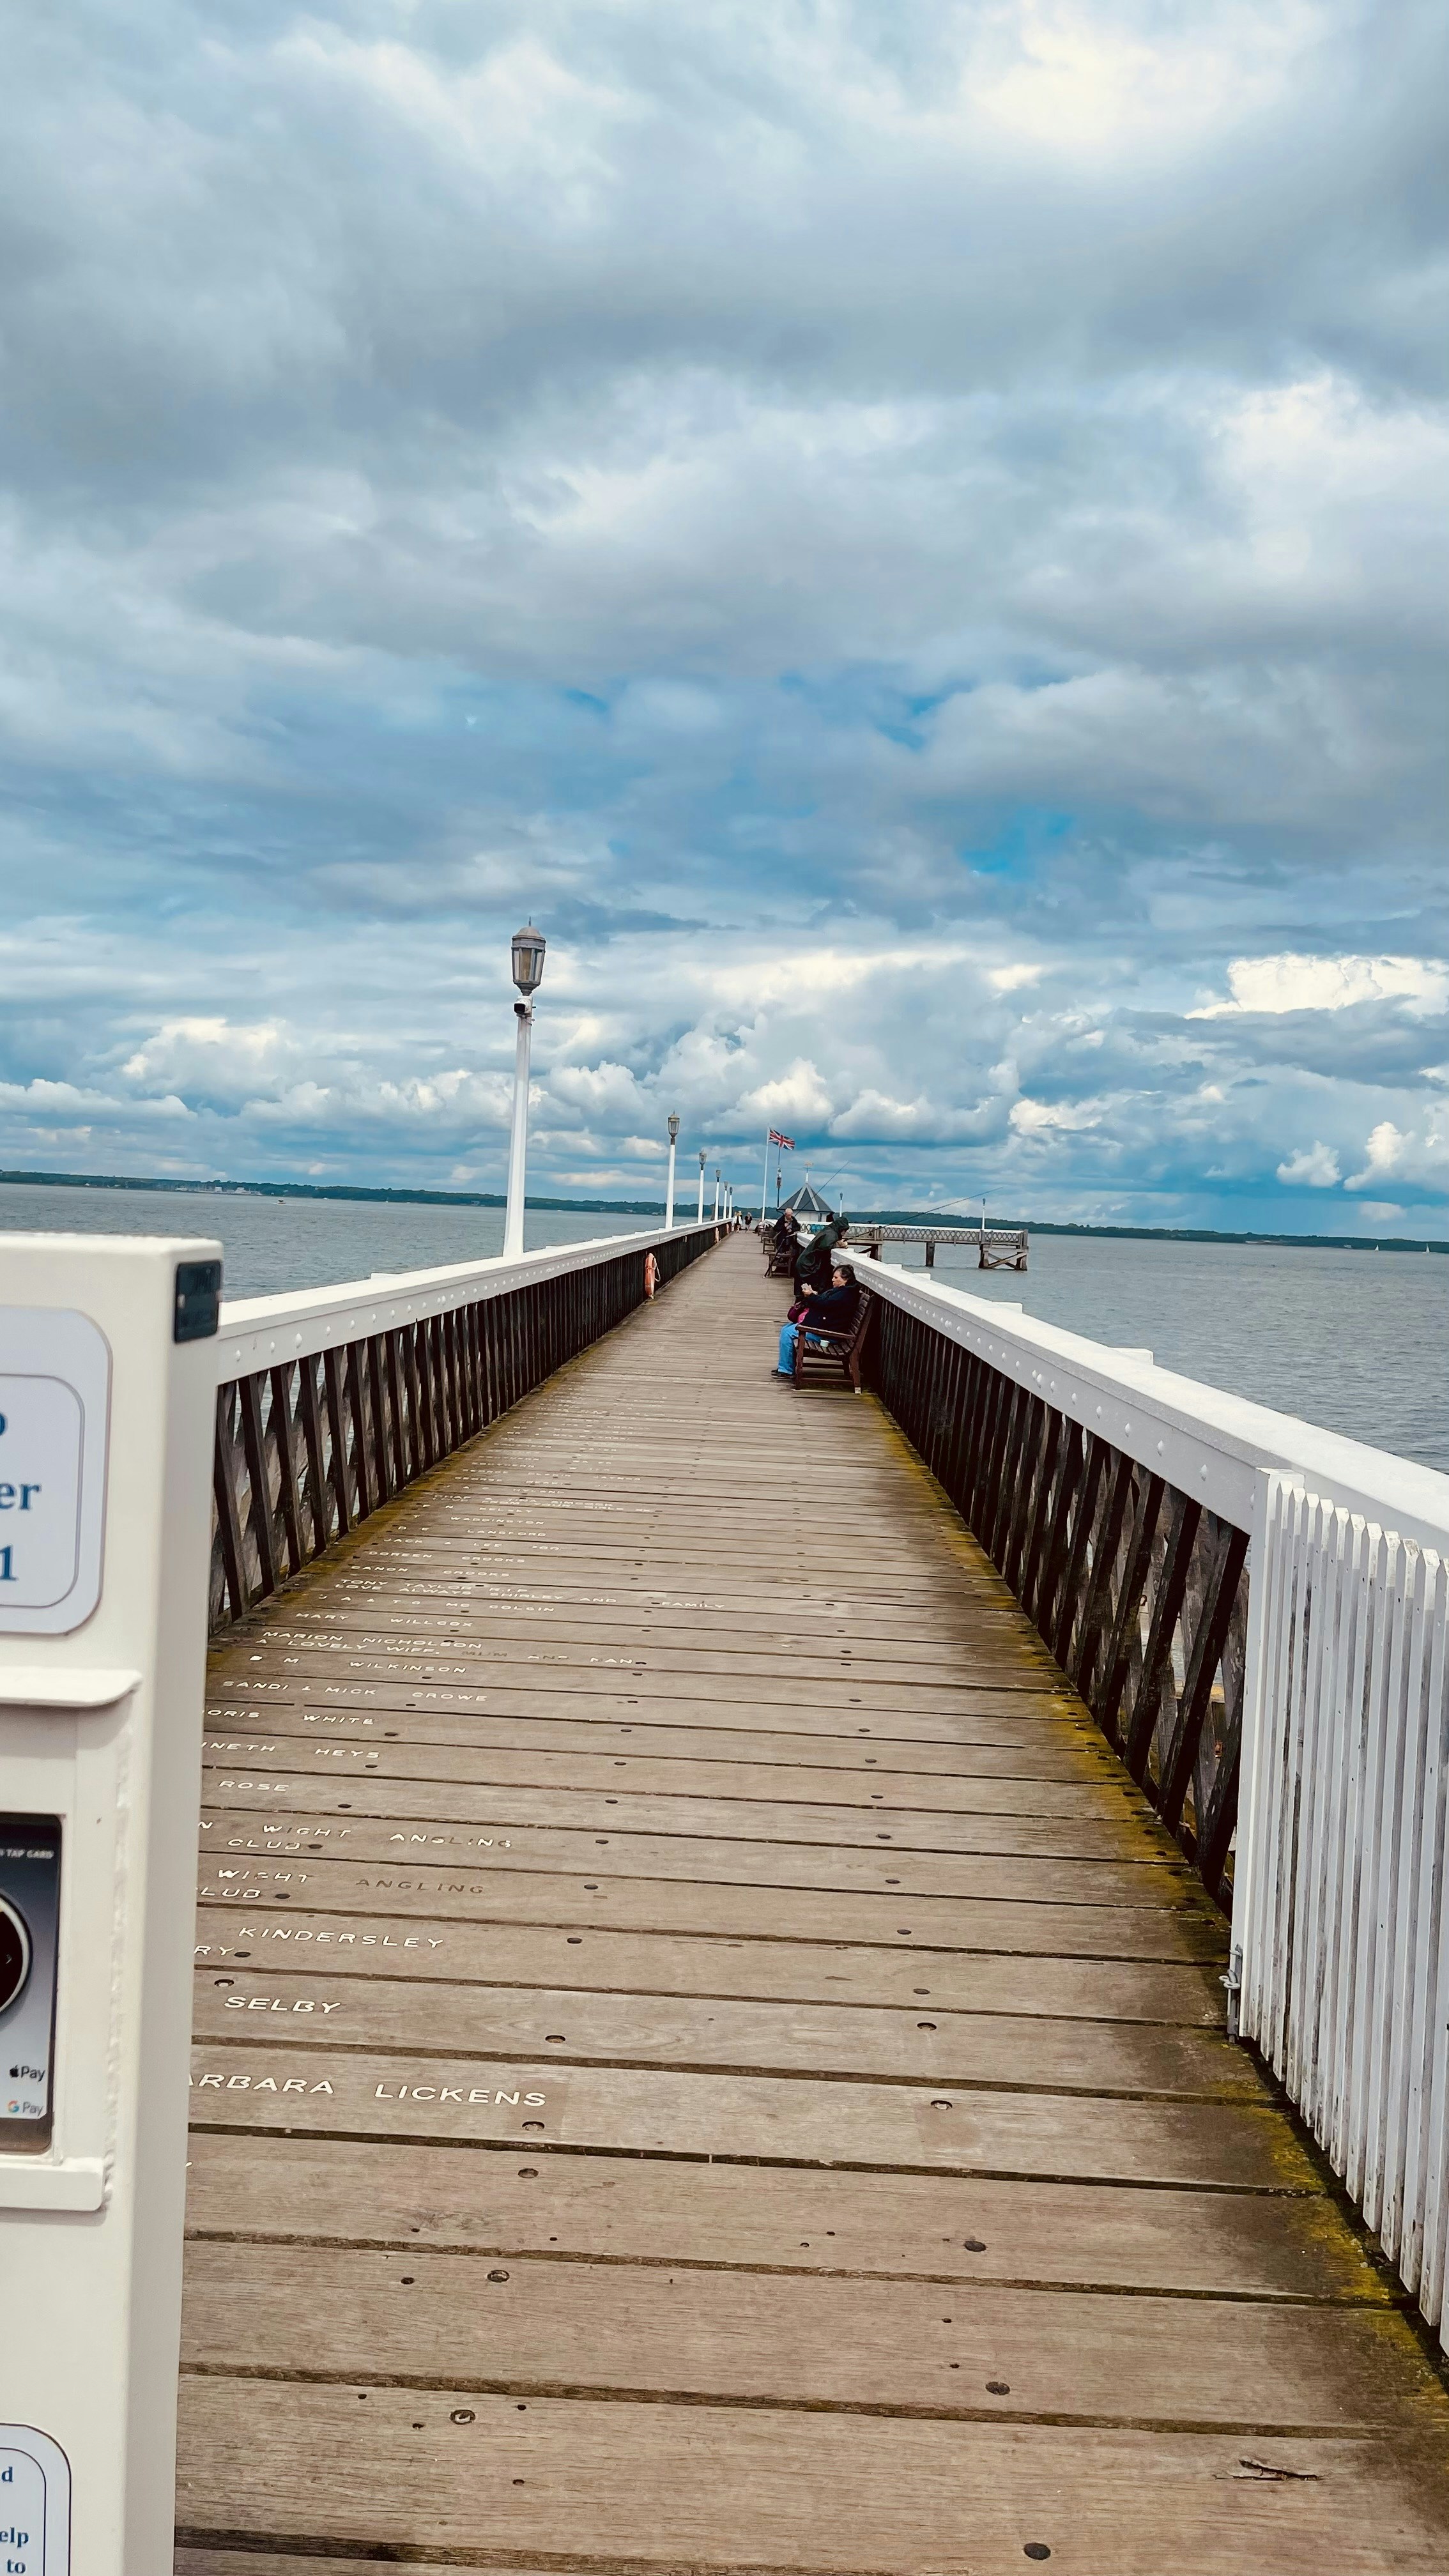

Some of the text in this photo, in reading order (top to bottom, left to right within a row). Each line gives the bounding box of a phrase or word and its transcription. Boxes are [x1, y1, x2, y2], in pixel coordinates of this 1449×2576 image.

[390, 1618, 473, 1627] WILLCOX
[263, 1632, 482, 1649] MARION NICHOLSON
[288, 1641, 367, 1650] LOVELY
[350, 1662, 466, 1673] WILKINSON
[223, 1681, 289, 1690] SANDI
[325, 1687, 376, 1695] MICK
[202, 1710, 373, 1725] ORIS WHITE
[315, 1748, 379, 1758] HEYS
[218, 1781, 289, 1791] ROSE
[263, 1825, 351, 1837] WIGHT
[390, 1833, 512, 1848] ANGLING
[196, 1887, 261, 1898] LUB
[356, 1879, 485, 1894] ANGLING
[238, 1928, 443, 1948] KINDERSLEY
[224, 1997, 341, 2014] SELBY
[21, 2066, 45, 2083] Pay
[374, 2084, 546, 2106] LICKENS
[23, 2101, 43, 2117] Pay
[7, 2557, 26, 2574] to
